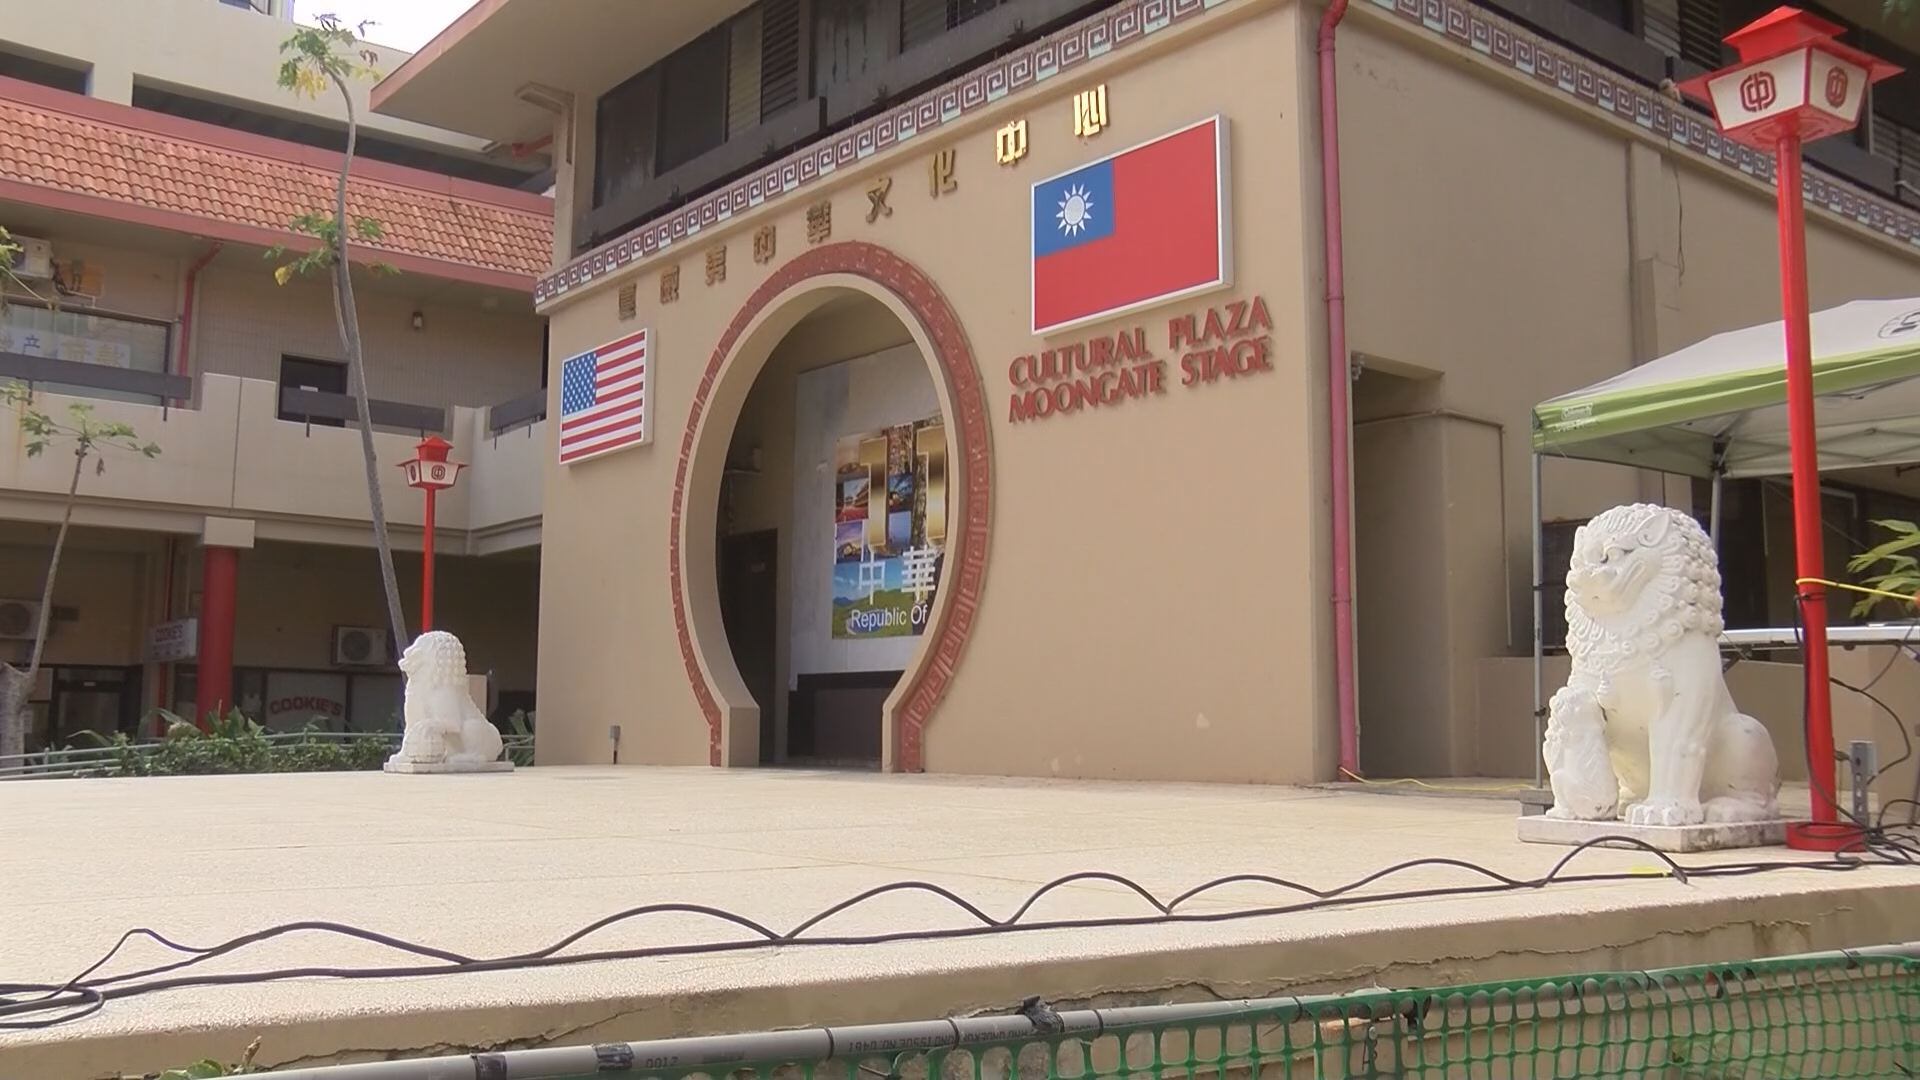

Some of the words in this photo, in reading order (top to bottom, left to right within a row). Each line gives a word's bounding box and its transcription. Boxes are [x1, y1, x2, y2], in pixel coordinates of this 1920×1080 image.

[1009, 327, 1150, 387] CULTURAL
[1168, 296, 1272, 350] PLAZA
[1009, 360, 1166, 423] MOONGATE
[1182, 335, 1274, 386] STAGE
[858, 545, 936, 606] 中華
[850, 607, 907, 632] Republic
[911, 603, 928, 625] Of
[269, 696, 343, 716] COOKIE'S
